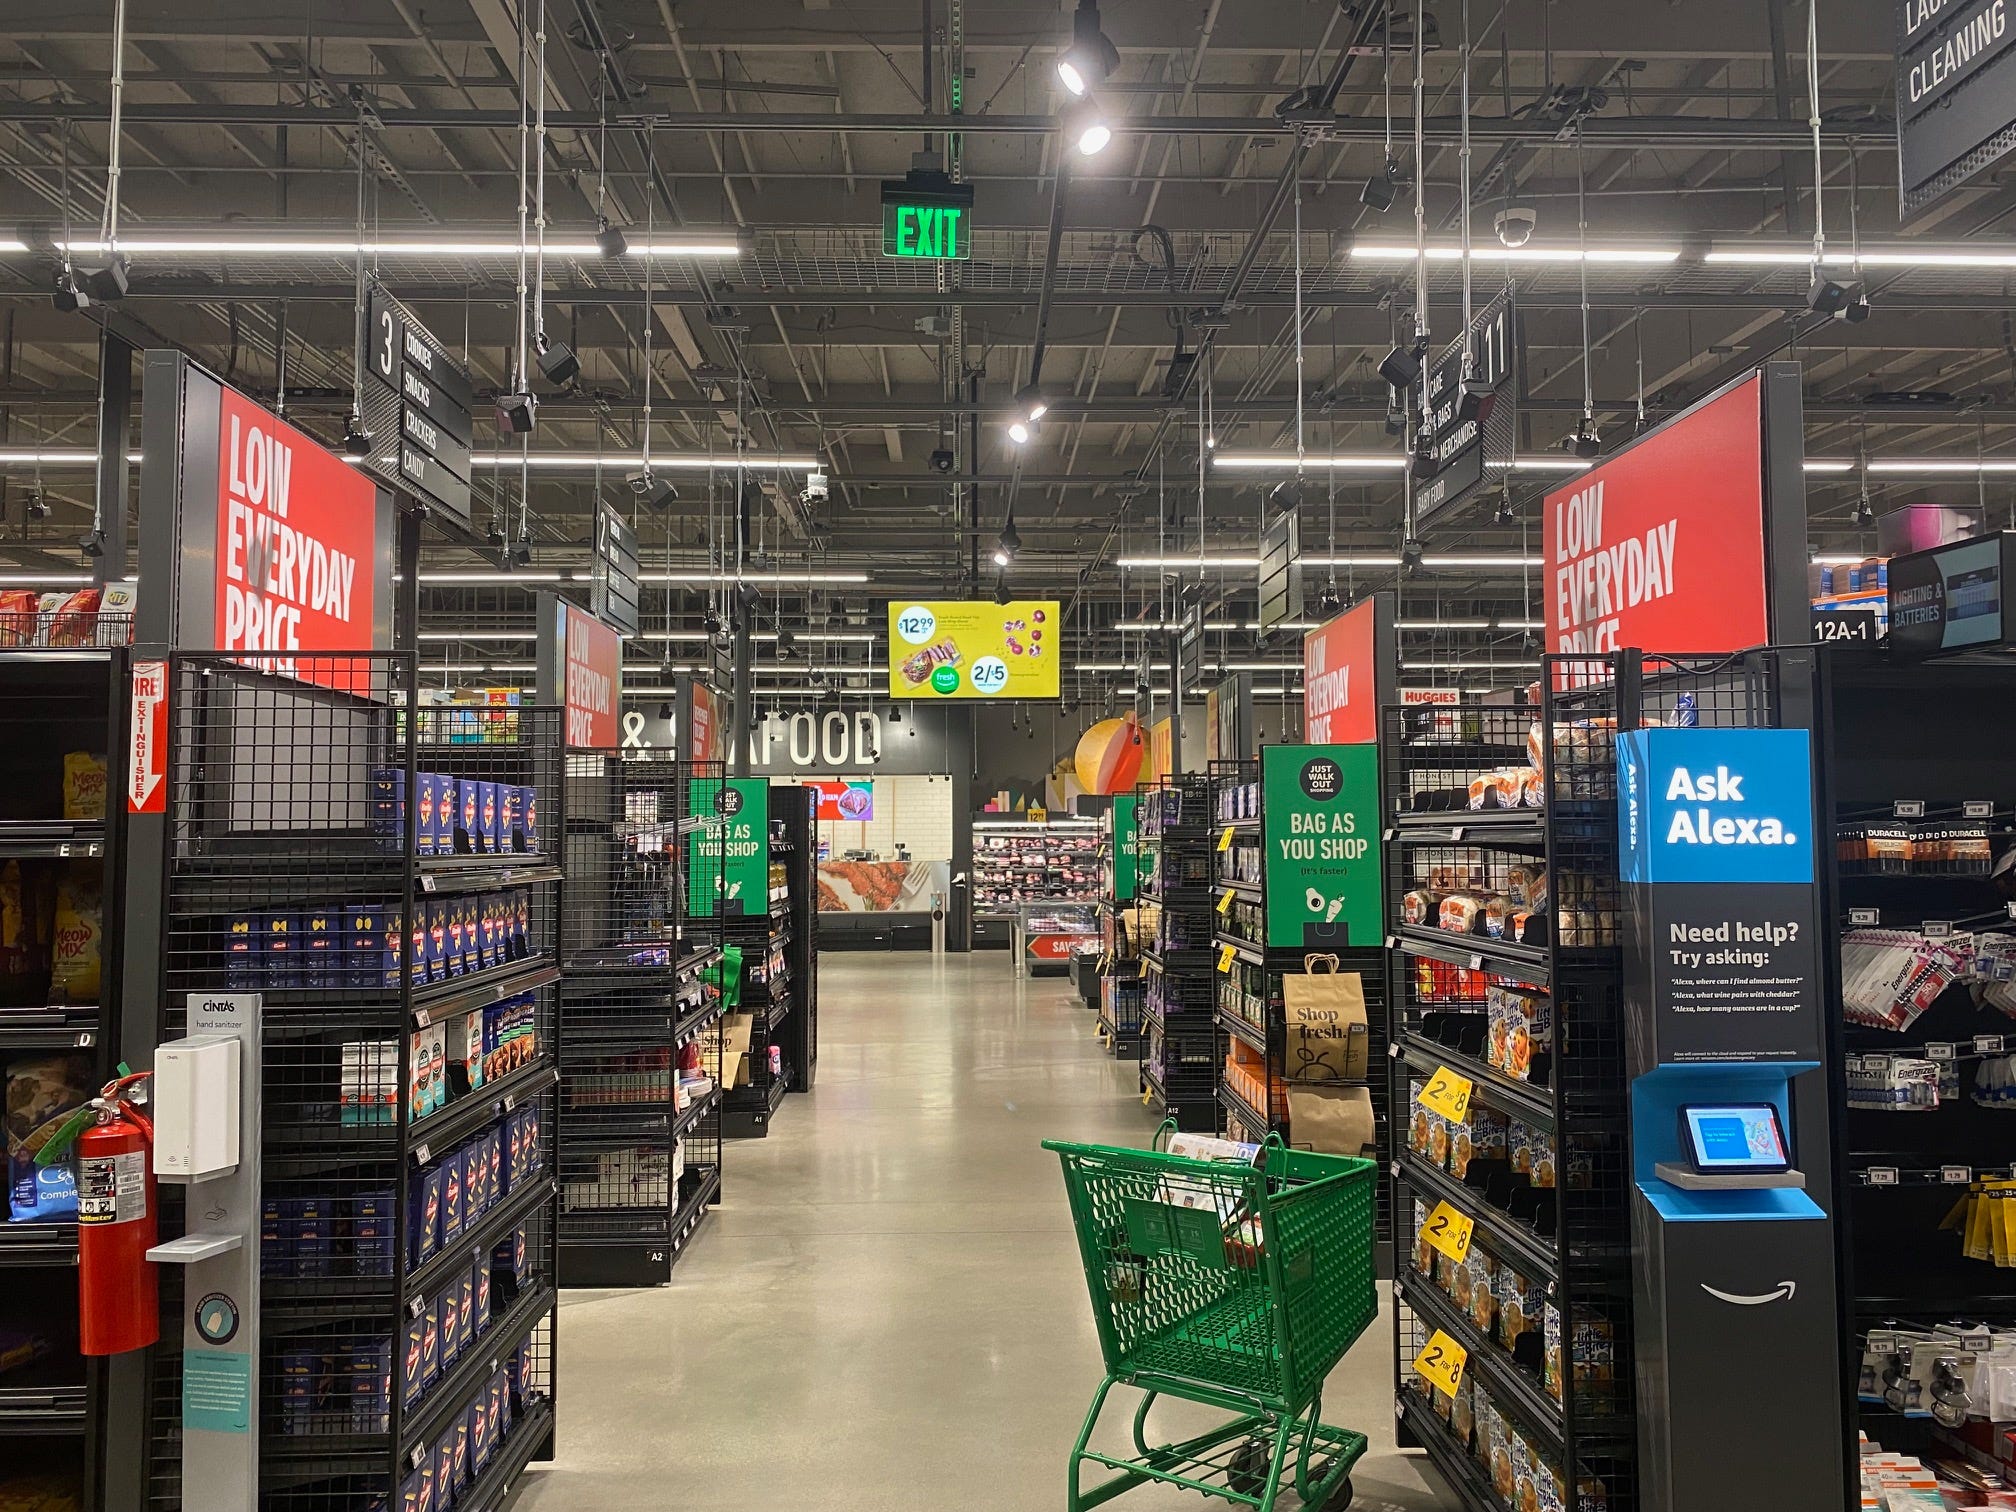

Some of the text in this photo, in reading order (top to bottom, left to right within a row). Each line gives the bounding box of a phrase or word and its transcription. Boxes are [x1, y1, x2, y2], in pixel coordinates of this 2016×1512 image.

[1909, 0, 2006, 103] CLEANING
[897, 207, 961, 257] EXIT
[380, 311, 393, 376] 3
[406, 331, 432, 371] COOKIES
[1485, 311, 1505, 384] 11
[405, 371, 430, 408] SNACKS
[1430, 371, 1443, 398] CARE
[1437, 401, 1452, 428] BAGS
[406, 410, 437, 450] CRACKERS
[1440, 420, 1478, 462] MERCHANDISE
[229, 413, 292, 519] LOW
[404, 449, 425, 480] CANDY
[1417, 479, 1446, 514] BABY FOOD
[600, 511, 606, 552] 2
[1557, 480, 1605, 565] LOW
[226, 498, 356, 623] EVERYDAY
[1557, 518, 1678, 631] EVERYDAY
[1894, 582, 1943, 607] LIGHTING &
[1814, 621, 1867, 640] 12A-1
[1894, 607, 1940, 628] BATTERIES
[225, 583, 301, 679] PRICE
[570, 615, 590, 665] LOW
[1308, 635, 1327, 678] LOW
[1559, 618, 1621, 692] PRICE
[134, 677, 159, 697] IRE
[569, 661, 611, 715] EVERYDAY
[936, 673, 955, 681] fresh
[1308, 665, 1350, 718] EVERYDAY
[1405, 691, 1457, 704] HUGGIES
[569, 708, 593, 748] PRICE
[1309, 714, 1332, 744] PRICE
[134, 700, 146, 799] EXTINGUISHER
[1308, 773, 1335, 781] WALK
[1310, 765, 1333, 773] JUST
[1312, 780, 1332, 788] OUT
[1666, 766, 1744, 802] Ask
[1628, 763, 1638, 851] Ask Alexa.
[706, 824, 751, 839] BAG AS
[1290, 813, 1355, 834] BAG AS
[1666, 809, 1796, 845] Alexa.
[1867, 829, 1908, 839] DURACELL
[1949, 829, 1987, 838] DURACELL
[60, 844, 99, 857] E F
[698, 841, 759, 857] YOU SHOP
[1280, 838, 1368, 860] YOU SHOP
[1319, 867, 1348, 876] faster)
[1670, 921, 1799, 947] Need help?
[1943, 935, 1972, 948] ergizer
[1670, 949, 1770, 968] Try asking:
[1733, 977, 1748, 986] find
[1891, 956, 1914, 991] Energizer
[1731, 991, 1749, 1000] pairs
[1749, 990, 1765, 998] with
[196, 1020, 243, 1029] hand sanitizer
[1297, 1008, 1339, 1023] Shop
[79, 1033, 91, 1047] D
[704, 1035, 732, 1047] Shop
[1299, 1025, 1347, 1039] fresh.
[1898, 1066, 1937, 1079] Energizer
[1427, 1080, 1448, 1100] 2
[1444, 1092, 1454, 1101] FOR
[1482, 1127, 1505, 1138] Bites
[1429, 1215, 1449, 1238] 2
[1446, 1229, 1457, 1241] FOR
[651, 1252, 663, 1261] A2
[1547, 1280, 1555, 1296] C
[1424, 1345, 1445, 1369] 2
[1440, 1359, 1451, 1371] FOR
